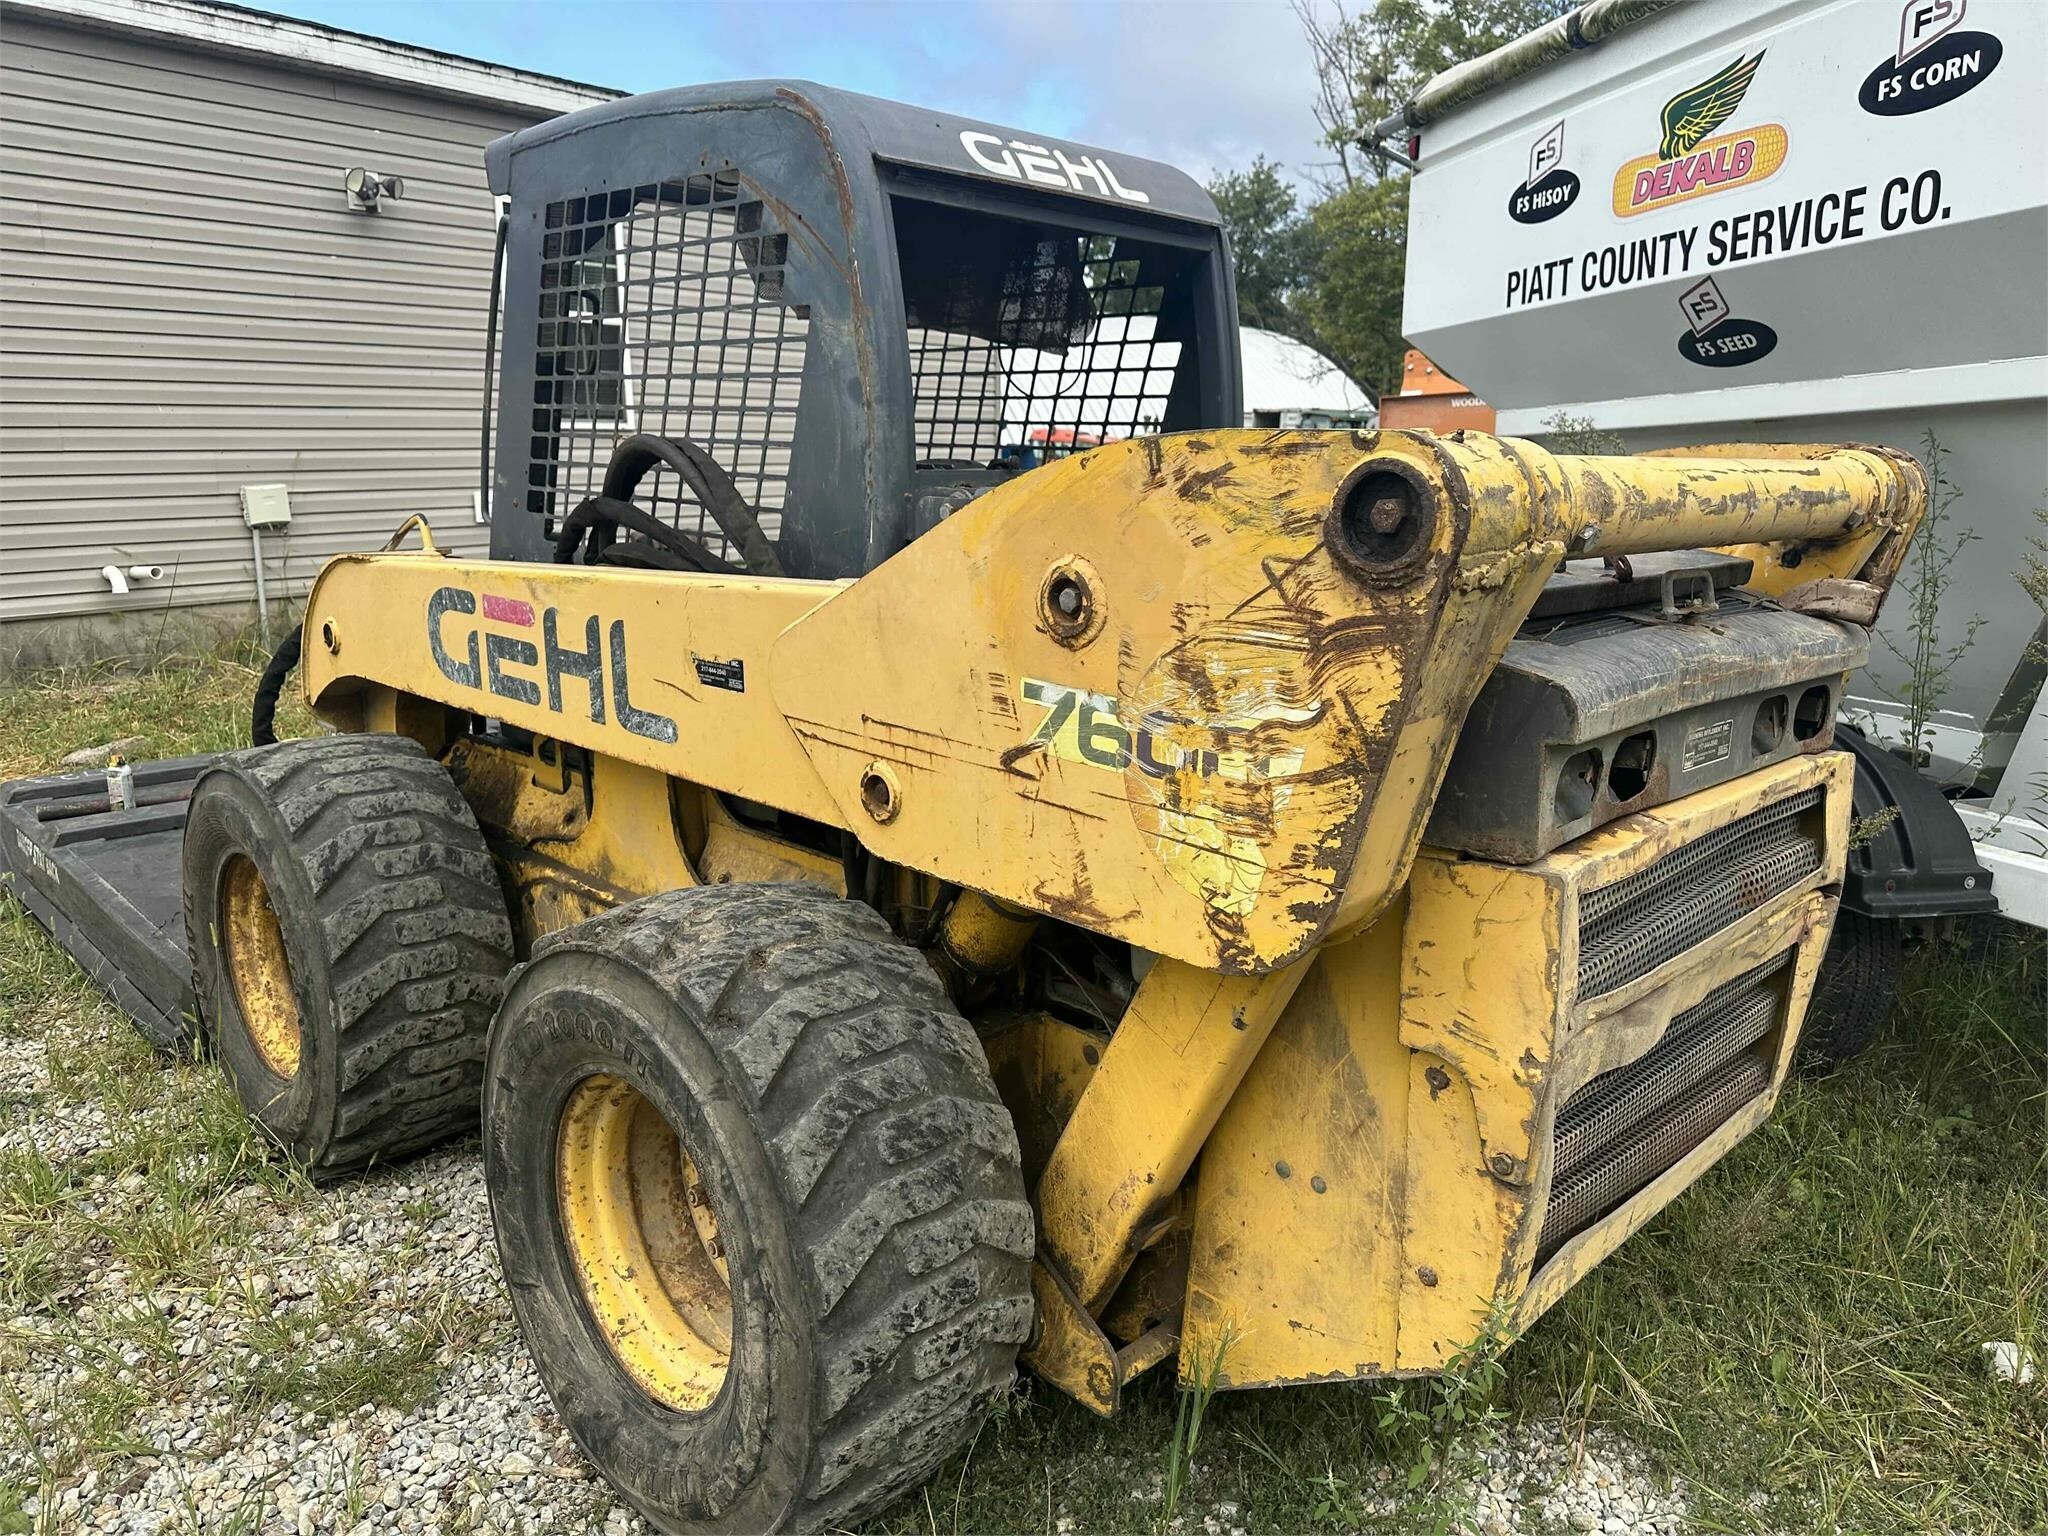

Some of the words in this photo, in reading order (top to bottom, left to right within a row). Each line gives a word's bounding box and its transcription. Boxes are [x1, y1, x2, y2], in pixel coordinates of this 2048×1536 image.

[1913, 0, 1953, 38] FS
[1878, 75, 1903, 102] FS
[1910, 49, 1981, 91] CORN
[959, 130, 1150, 203] GEHL
[1536, 138, 1556, 170] FS
[1631, 140, 1756, 206] DEKALB
[1516, 195, 1530, 214] FS
[1506, 256, 1574, 309] PIATT
[1581, 226, 1699, 292] COUNTY
[1707, 186, 1867, 266] SERVICE
[1881, 169, 1951, 231] CO.
[1690, 291, 1718, 320] FS
[1695, 341, 1716, 357] FS
[1716, 333, 1758, 354] SEED
[428, 586, 679, 745] GEHL
